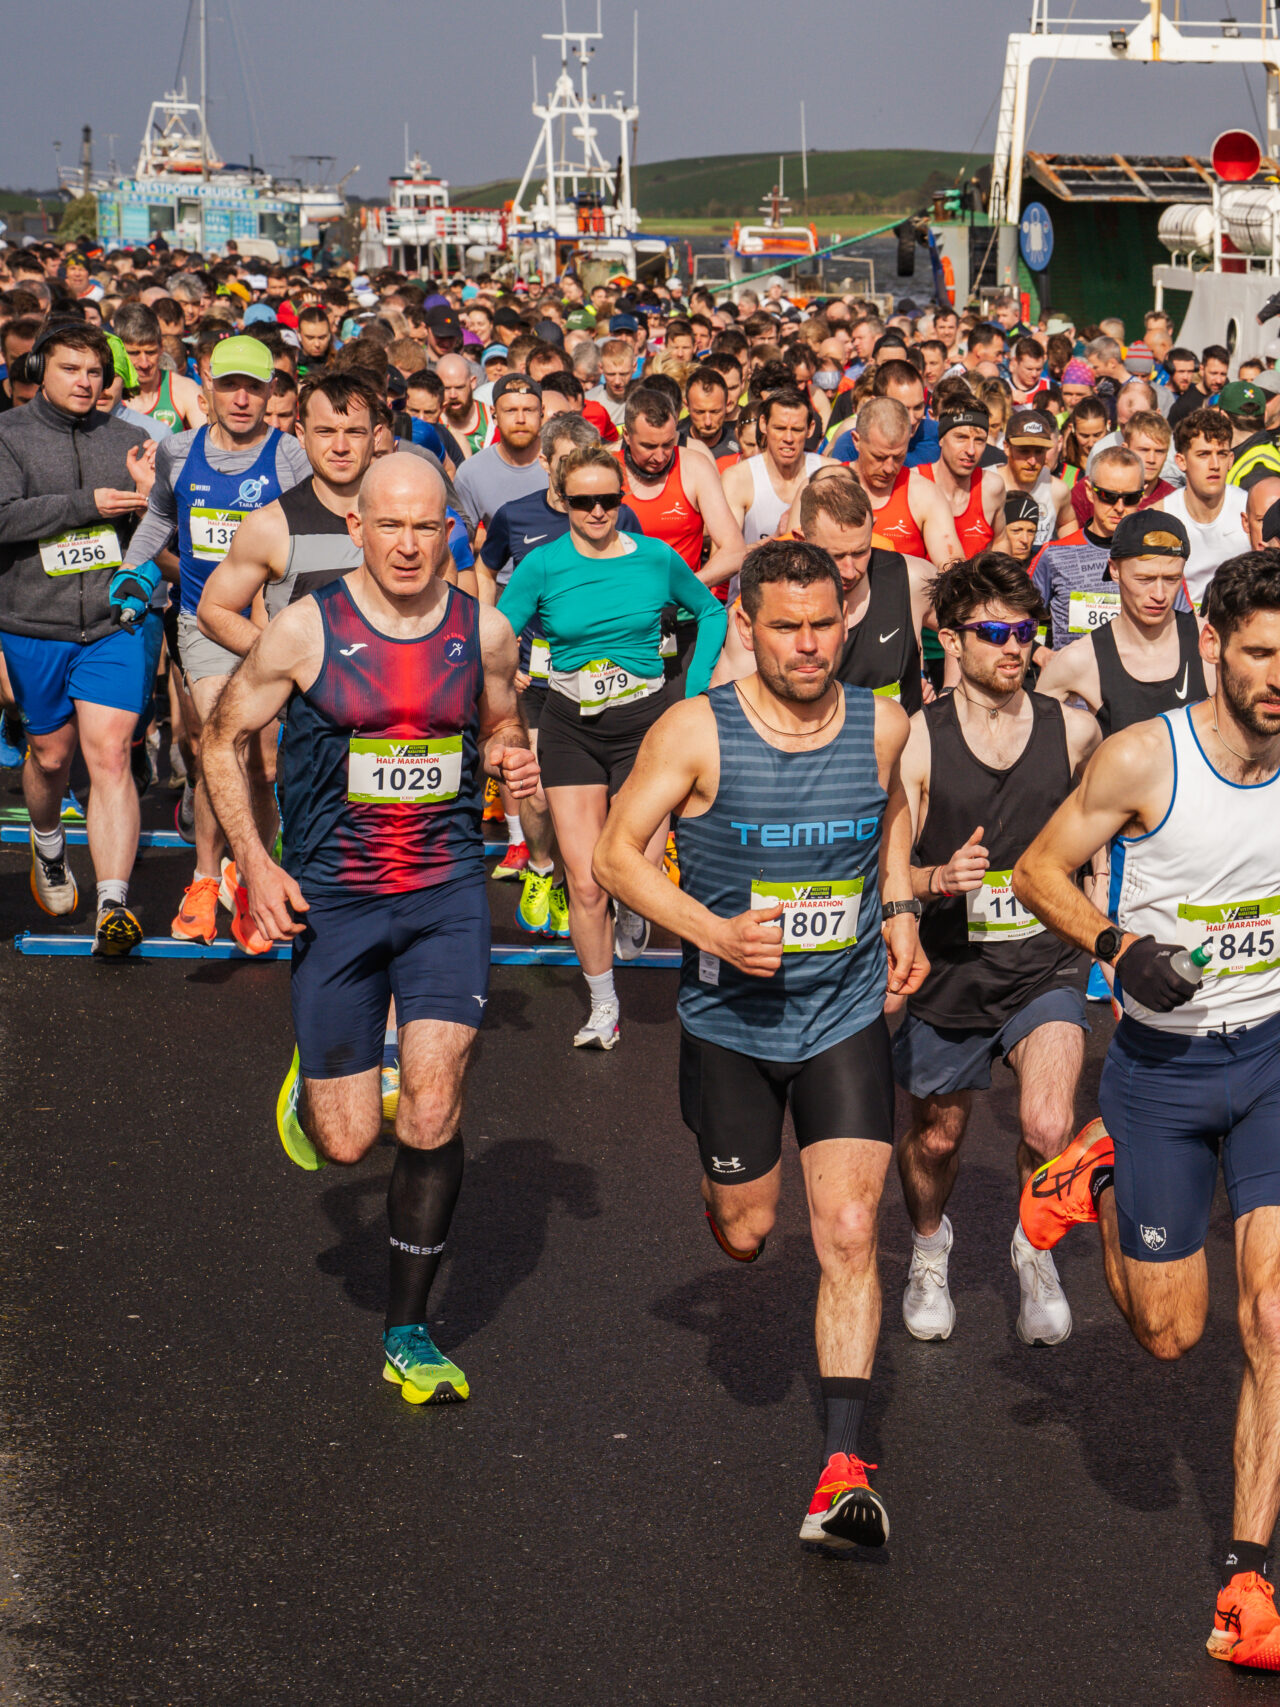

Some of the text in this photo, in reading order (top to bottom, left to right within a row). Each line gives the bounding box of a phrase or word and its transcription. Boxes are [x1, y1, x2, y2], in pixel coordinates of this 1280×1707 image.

[134, 181, 243, 199] WESTPORT CRUISES
[57, 545, 106, 566] 1256
[1081, 562, 1105, 572] BMW
[594, 673, 628, 696] 979
[397, 757, 440, 765] MARATHON
[372, 767, 442, 791] 1029
[730, 816, 879, 848] TEMPO
[778, 900, 843, 909] HALF MARATHON
[990, 896, 1031, 918] 11
[1206, 918, 1272, 932] HALF MARATHON
[390, 1236, 445, 1255] PRESS
